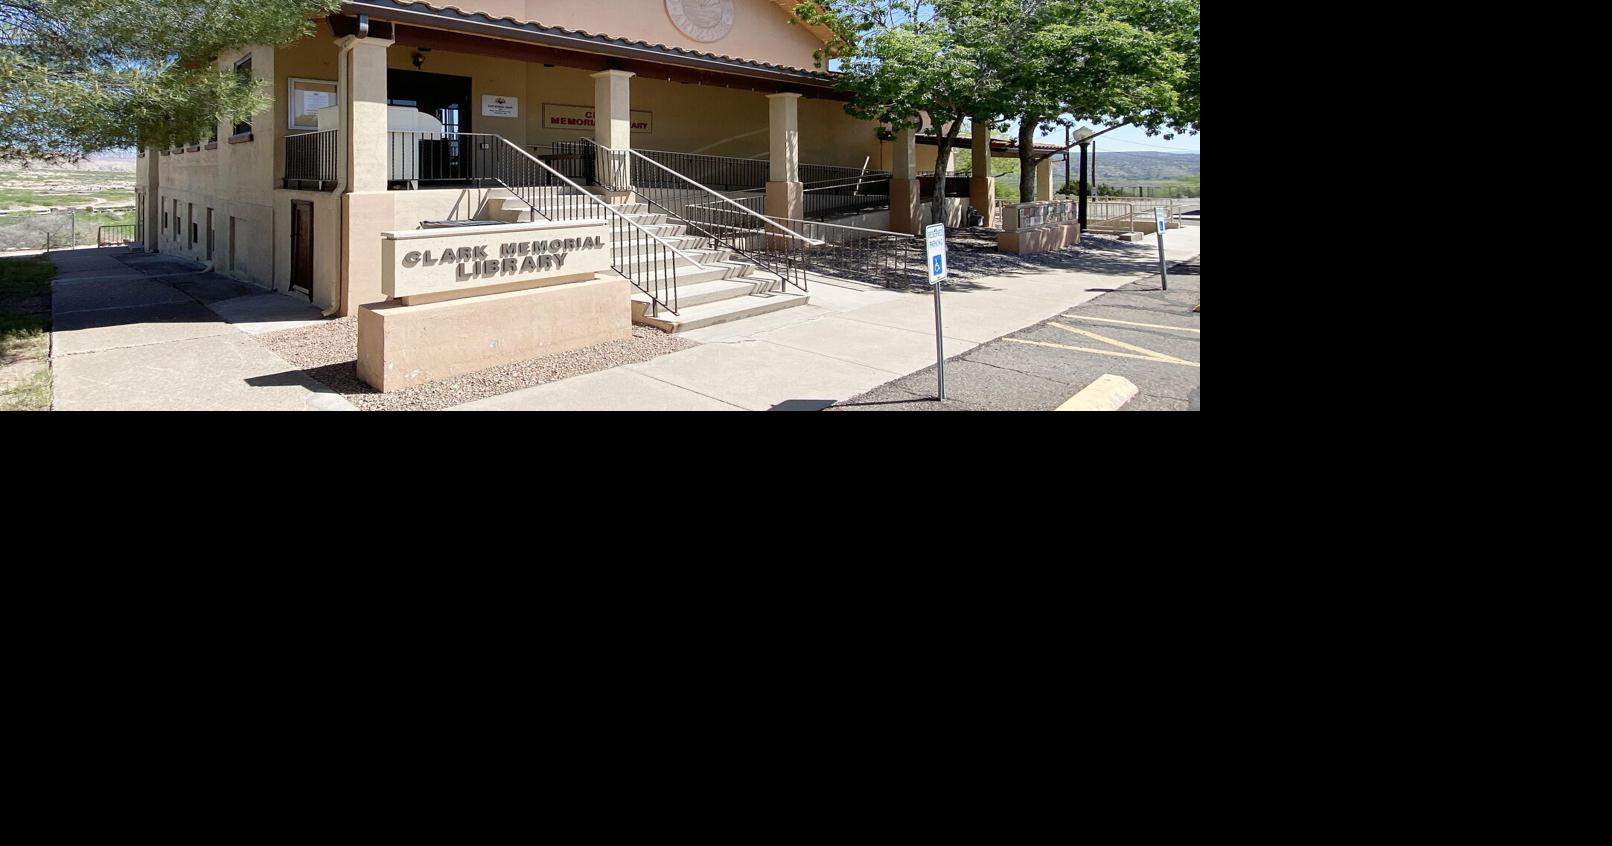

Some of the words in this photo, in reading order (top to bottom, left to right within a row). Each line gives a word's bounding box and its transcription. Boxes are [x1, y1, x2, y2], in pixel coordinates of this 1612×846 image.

[402, 244, 488, 269] CLARK
[499, 235, 605, 259] MEMORIAL
[455, 252, 568, 283] LIBRARY
